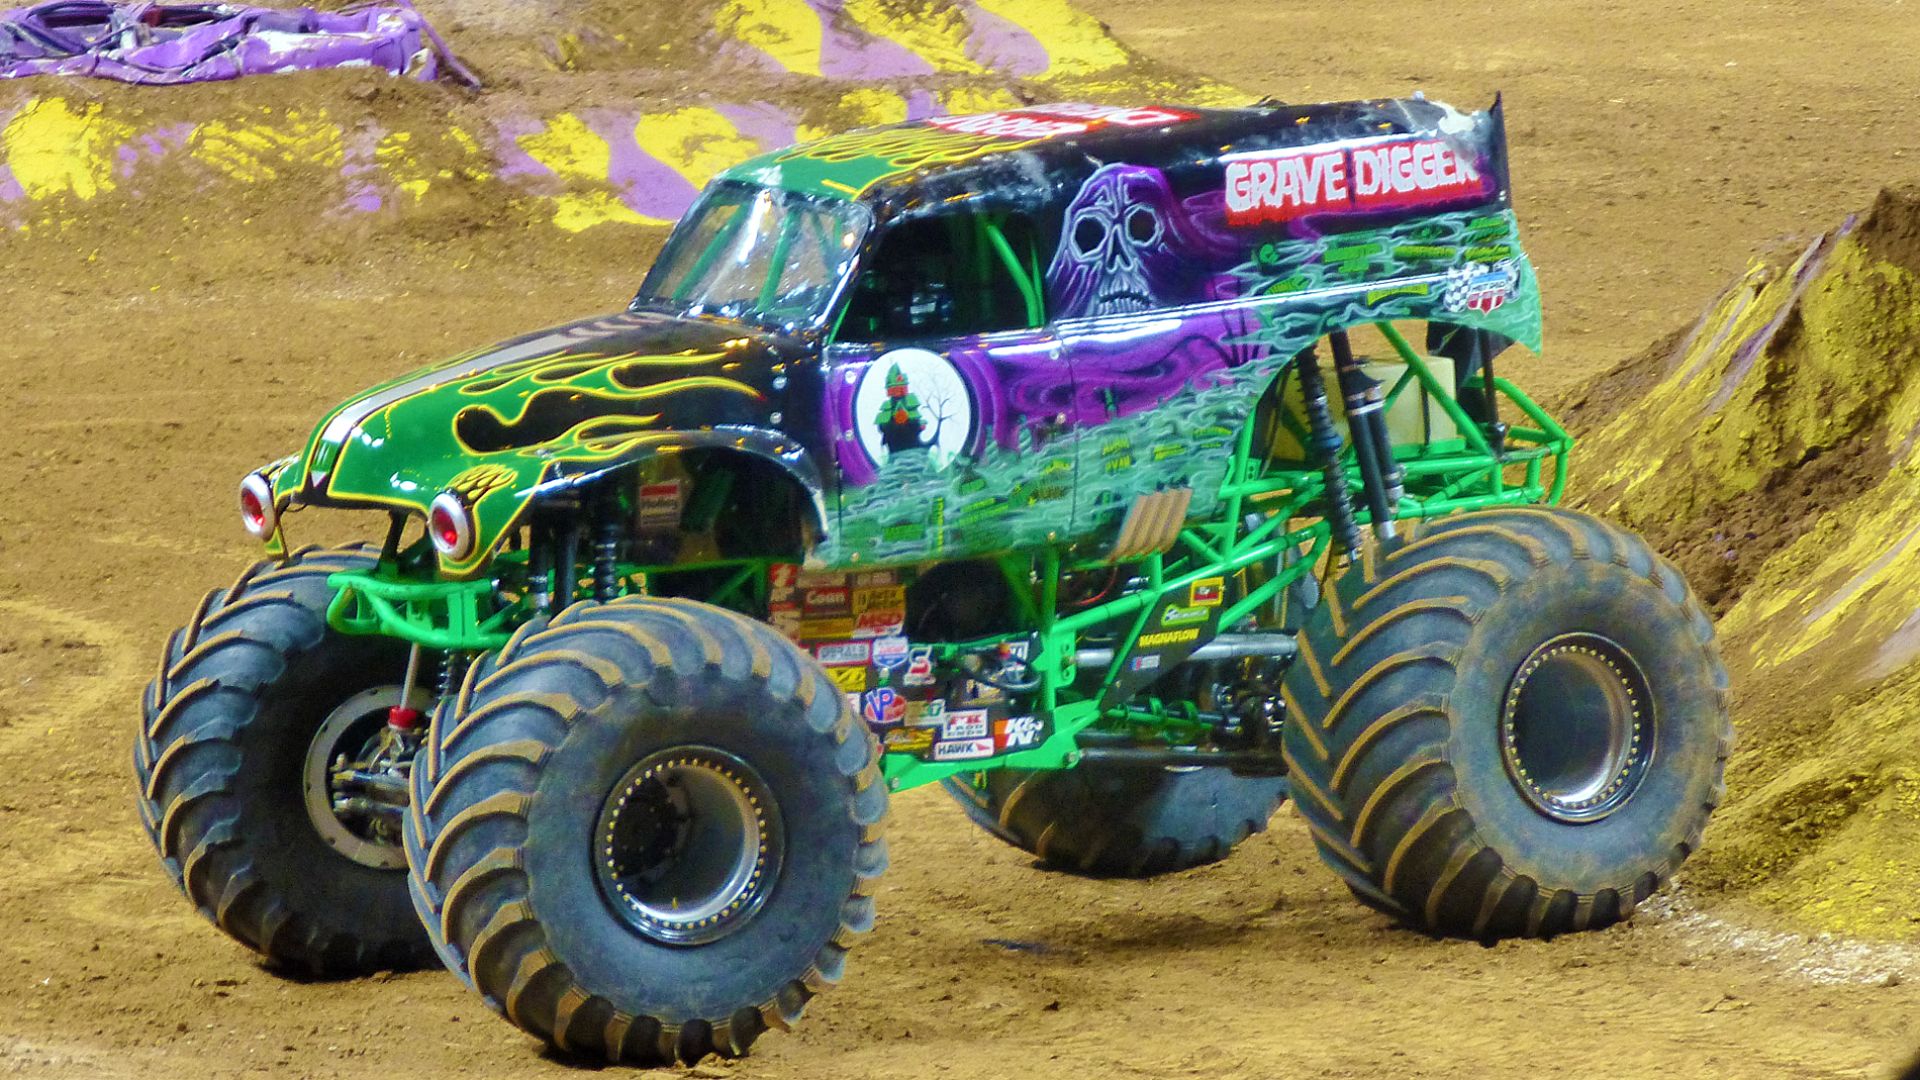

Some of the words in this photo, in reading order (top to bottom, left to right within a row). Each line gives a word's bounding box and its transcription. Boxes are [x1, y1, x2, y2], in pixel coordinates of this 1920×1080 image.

[1225, 151, 1347, 212] GRAVE
[1138, 629, 1201, 648] MAGNAFLOW
[865, 686, 896, 722] VP
[937, 742, 974, 757] HAWK
